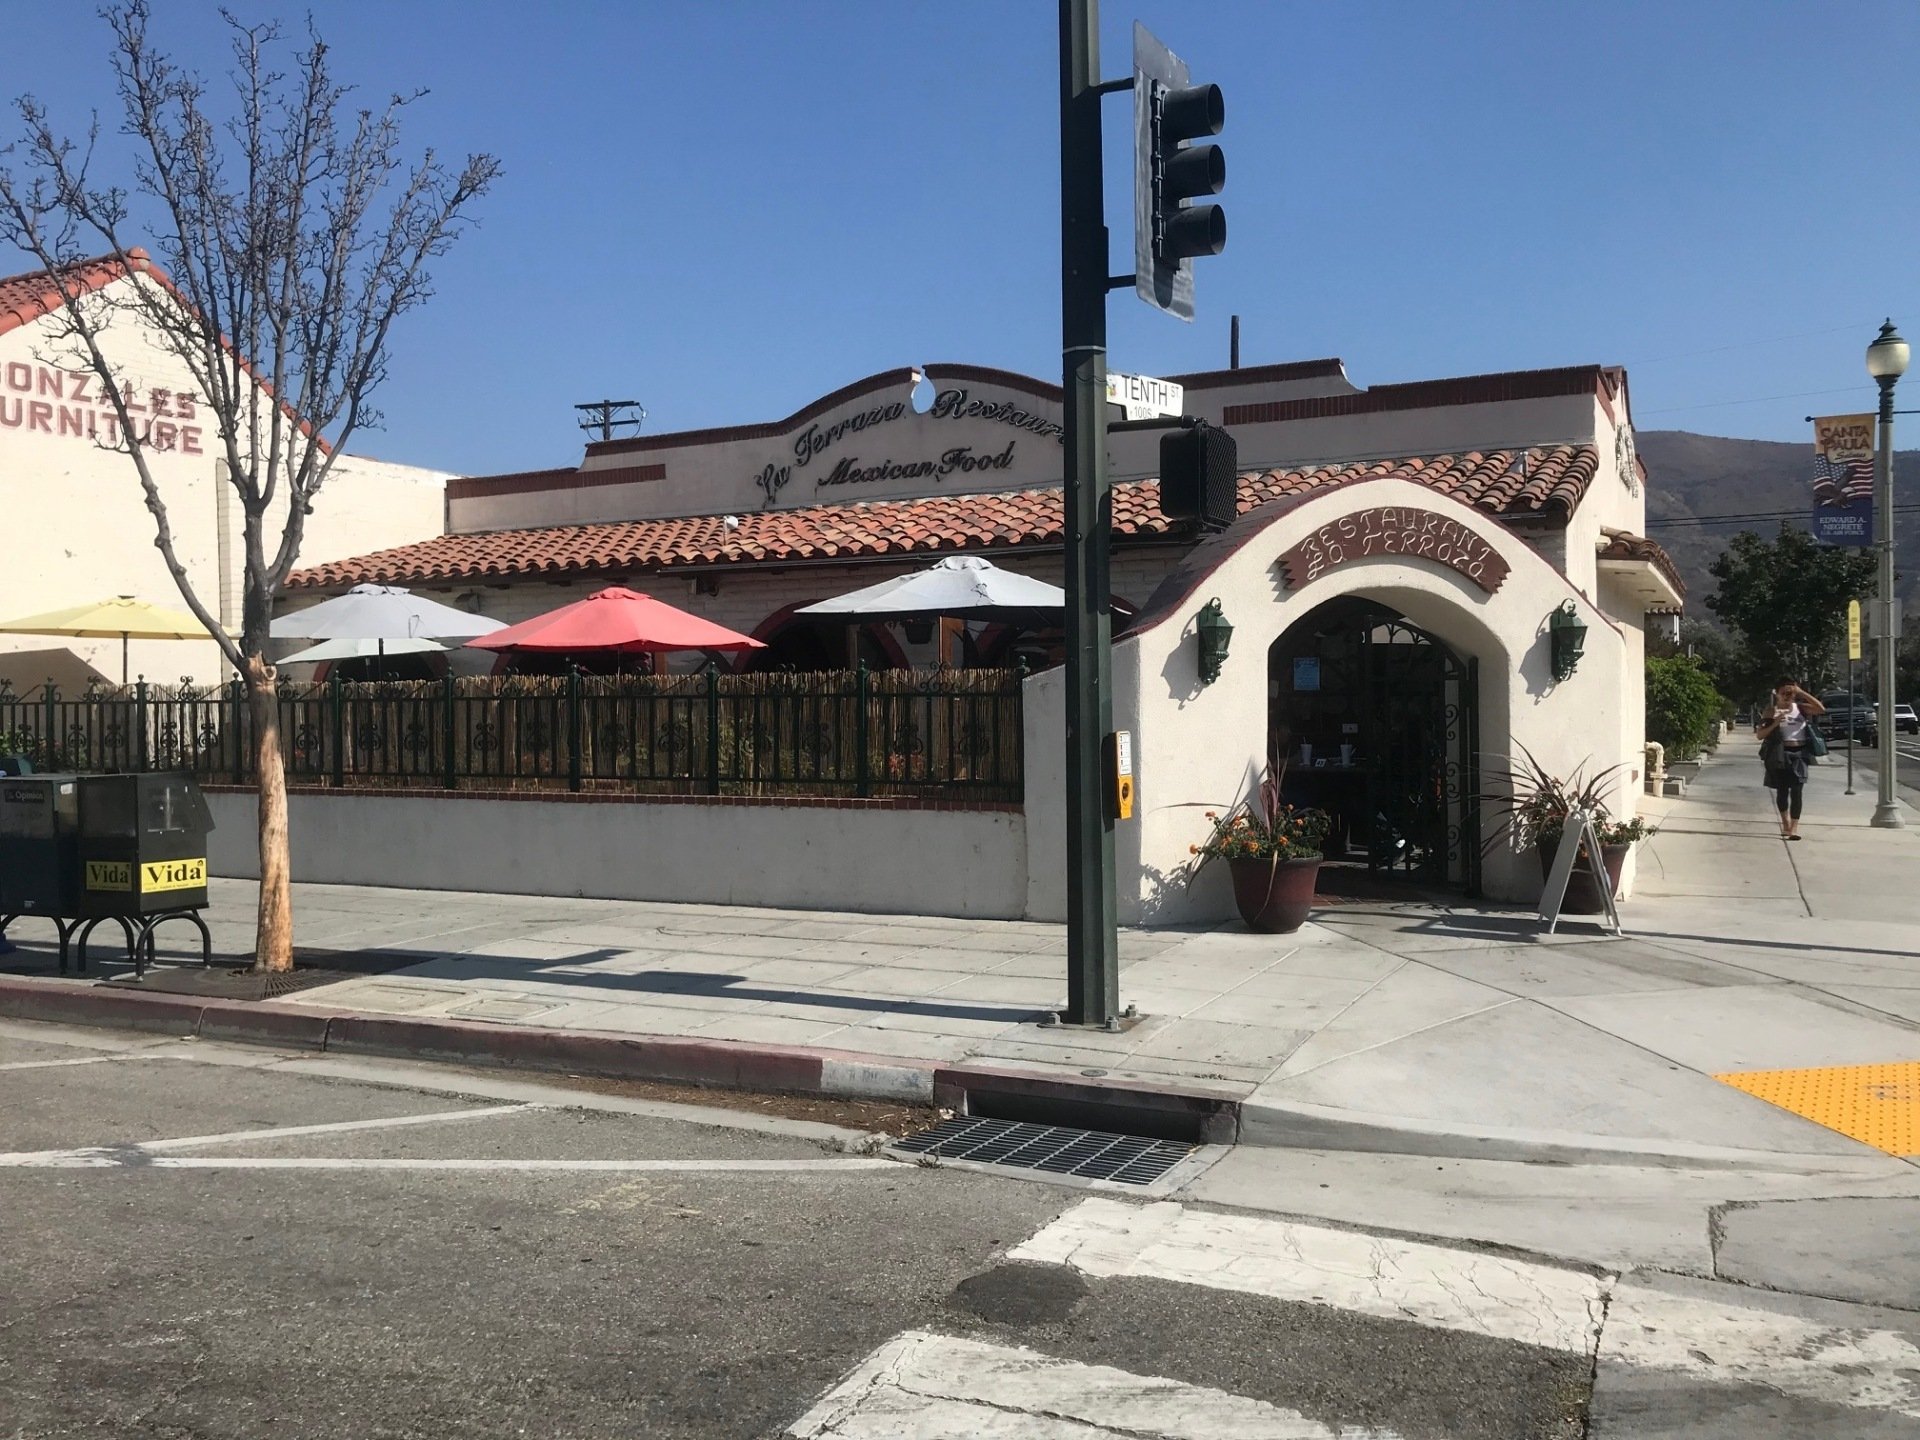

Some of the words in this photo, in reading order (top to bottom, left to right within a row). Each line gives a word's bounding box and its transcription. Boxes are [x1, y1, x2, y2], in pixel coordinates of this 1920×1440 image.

[0, 361, 195, 419] ONZLES
[1121, 375, 1168, 407] TENTH
[0, 396, 203, 456] URNITURE
[794, 401, 905, 466] Terraza
[933, 389, 1064, 445] Restaur
[1820, 425, 1870, 438] SANTA
[1820, 437, 1870, 455] PAULA
[818, 457, 936, 486] Mexican
[937, 441, 1015, 475] Food
[1301, 508, 1498, 561] RESTAURANT
[1820, 516, 1857, 524] EDWARD
[89, 864, 129, 883] Vida
[147, 863, 202, 883] Vida
